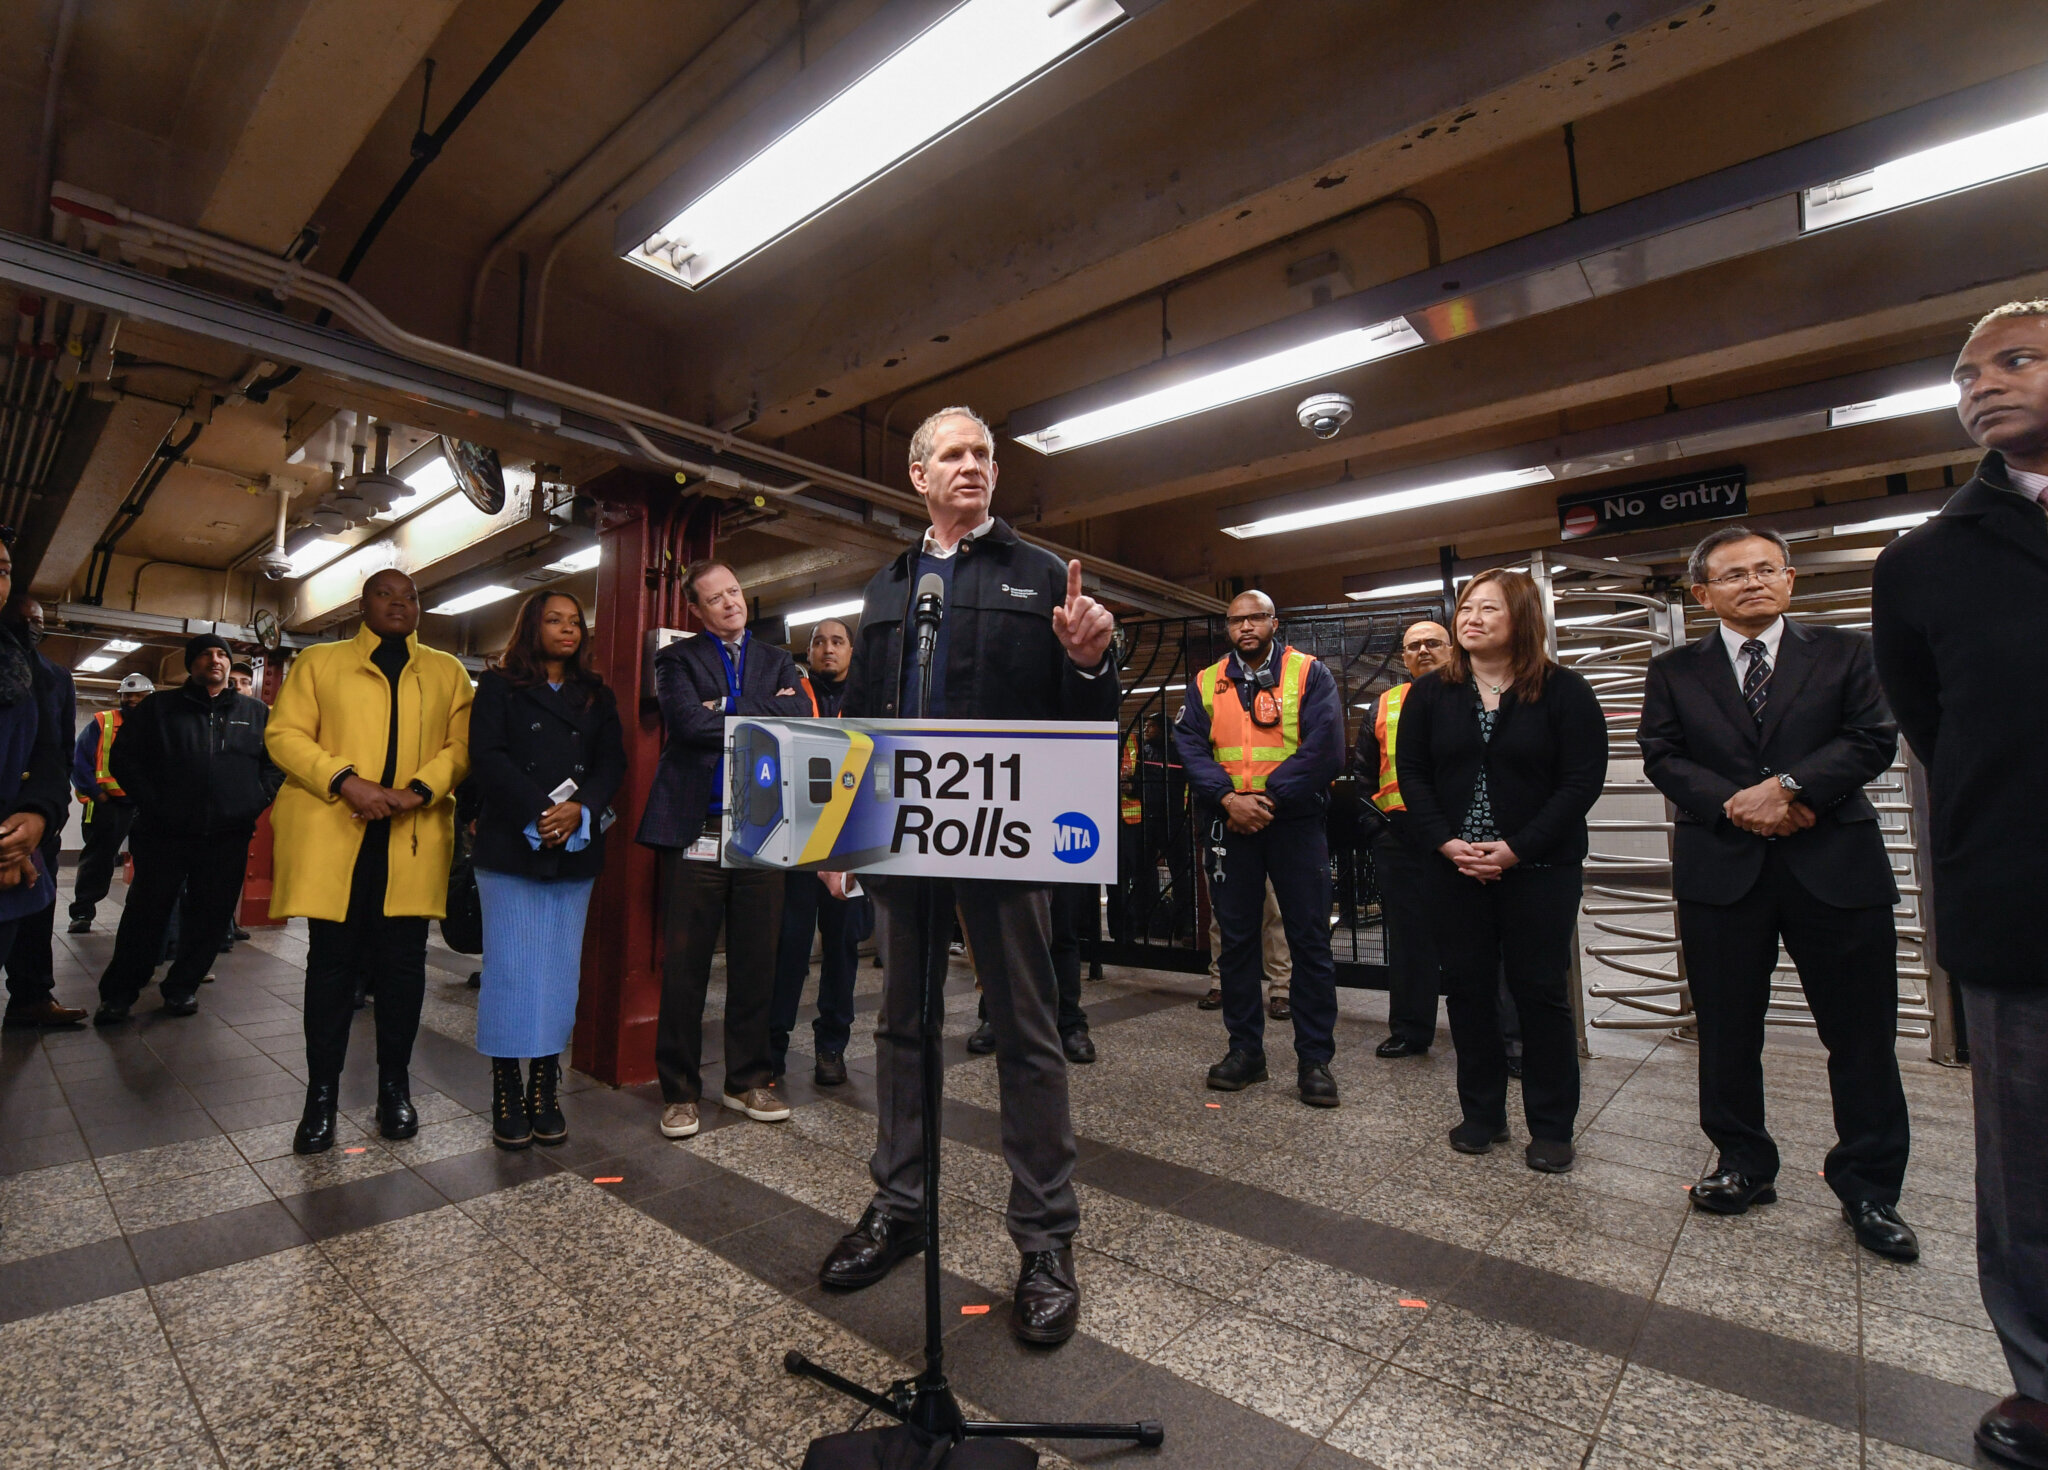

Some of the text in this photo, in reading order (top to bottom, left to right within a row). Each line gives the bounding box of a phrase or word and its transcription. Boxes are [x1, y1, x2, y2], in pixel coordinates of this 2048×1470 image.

[1603, 482, 1742, 520] No entry
[760, 762, 771, 780] A
[893, 749, 1021, 801] R211
[890, 804, 1032, 860] Rolls
[1051, 822, 1092, 853] MTA
